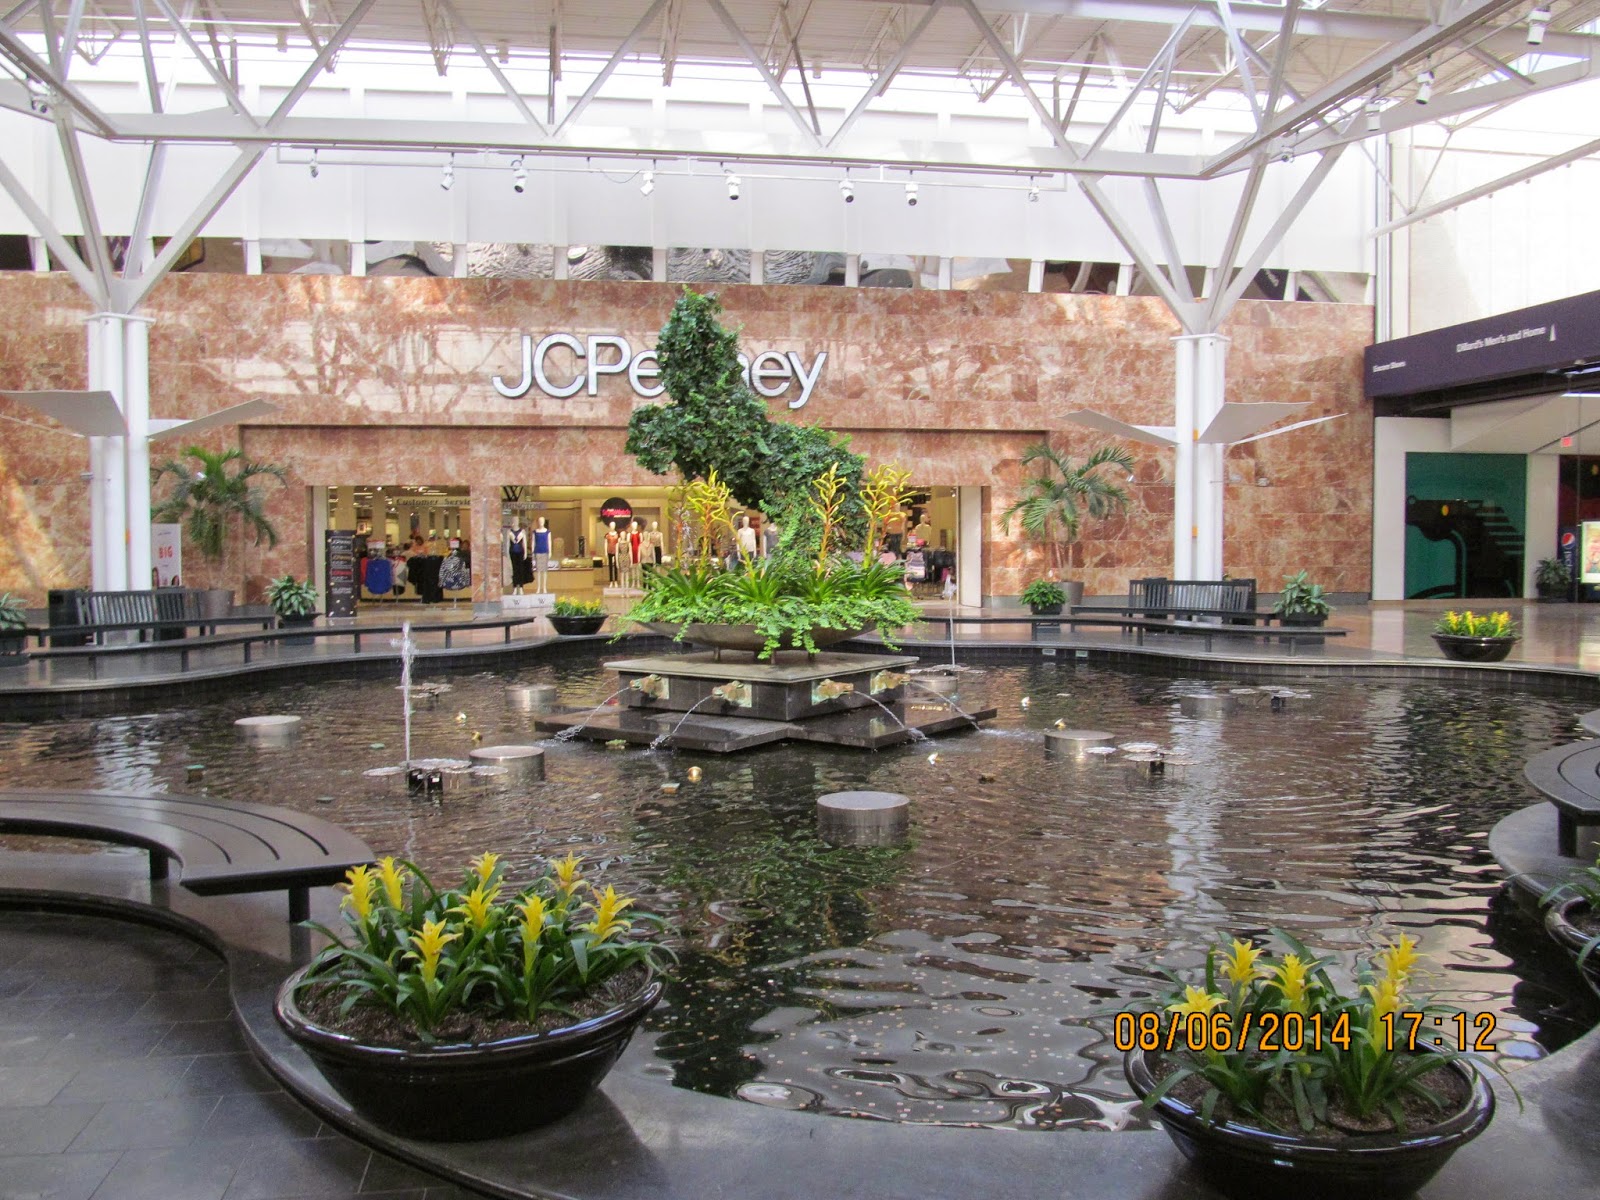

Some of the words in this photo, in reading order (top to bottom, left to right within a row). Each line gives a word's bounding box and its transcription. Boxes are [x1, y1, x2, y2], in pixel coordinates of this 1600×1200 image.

[1506, 330, 1522, 342] and
[1522, 327, 1546, 339] Home
[492, 333, 828, 409] JCPeey
[444, 498, 471, 507] Servic
[159, 545, 173, 559] BIG
